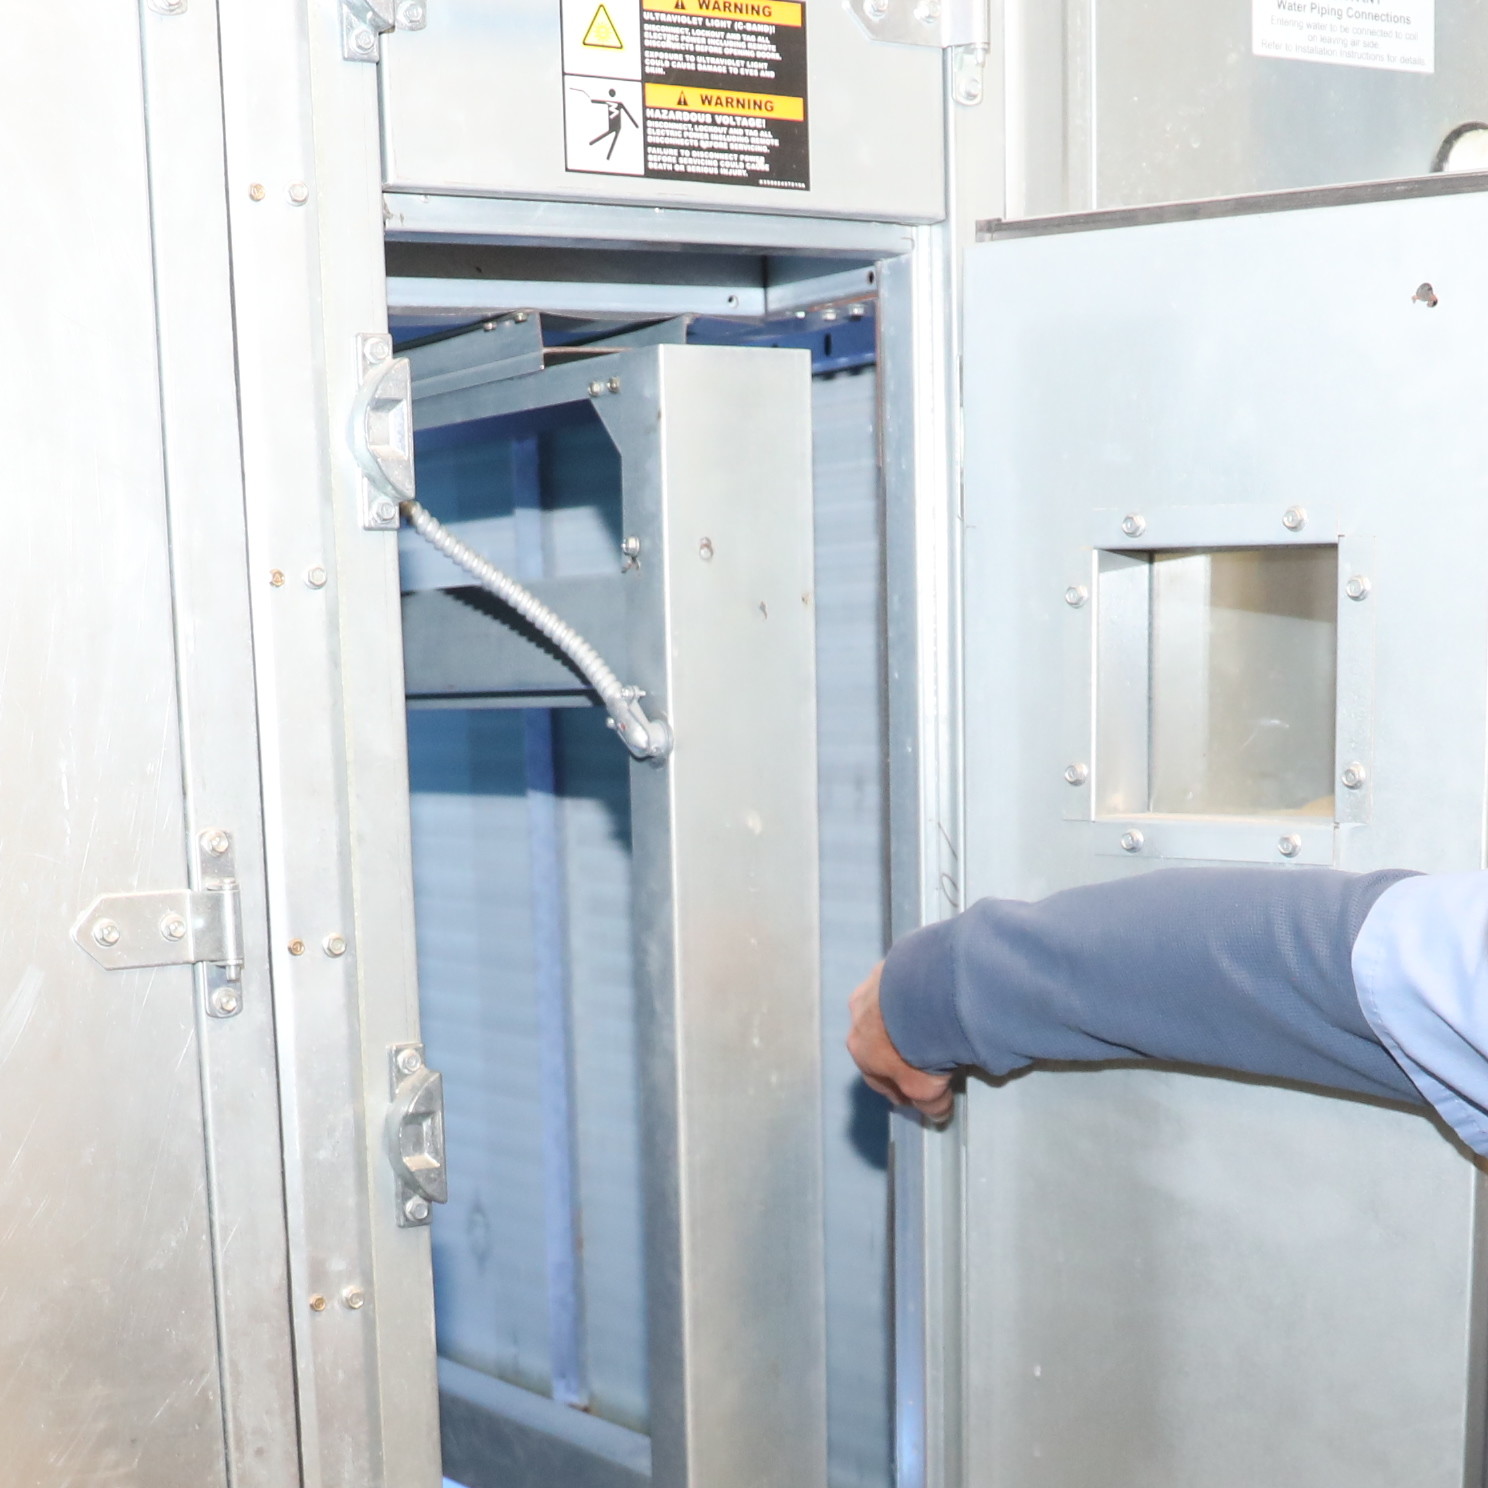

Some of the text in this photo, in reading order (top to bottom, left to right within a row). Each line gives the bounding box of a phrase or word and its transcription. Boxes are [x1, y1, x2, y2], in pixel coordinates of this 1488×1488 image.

[698, 0, 772, 17] WARNING
[1277, 0, 1411, 25] Water Piping Connections
[643, 11, 703, 26] ULTRAVIOLET
[705, 18, 732, 29] LIGHT
[1271, 15, 1418, 40] Entering water to be connected to coil
[644, 24, 690, 35] DISCONNECT,
[692, 28, 725, 39] LOCKOUT
[726, 32, 741, 41] AND
[742, 33, 756, 42] TAG
[644, 31, 679, 42] ELECTRIC
[680, 34, 706, 45] POWER
[707, 38, 746, 49] INCLUDING
[1308, 34, 1317, 42] on
[644, 39, 694, 51] DISCONNECTS
[695, 44, 723, 54] BEFORE
[724, 47, 755, 57] OPENING
[644, 50, 768, 70] EXPOSURE TO ULTRAVIOLET LIGHT
[644, 58, 775, 79] COULD CAUSE DAMAGE TO EYES AND
[700, 94, 774, 112] WARNING
[646, 108, 766, 128] HAZARDOUS VOLTAGE!
[646, 120, 693, 132] DISCONNECT,
[694, 124, 727, 135] LOCKOUT
[728, 127, 744, 136] AND
[744, 128, 758, 137] TAG
[647, 127, 682, 138] ELECTRIC
[683, 130, 709, 140] POWER
[710, 133, 749, 144] INCLUDING
[647, 135, 699, 147] DISCONNECTS
[647, 146, 678, 156] FAILURE
[679, 149, 690, 158] TO
[691, 150, 738, 161] DISCONNECT
[647, 154, 677, 164] BEFORE
[678, 157, 718, 167] SERVICING
[719, 160, 744, 169] COULD
[648, 161, 673, 171] DEATH
[674, 164, 685, 172] OR
[686, 165, 719, 175] SERIOUS
